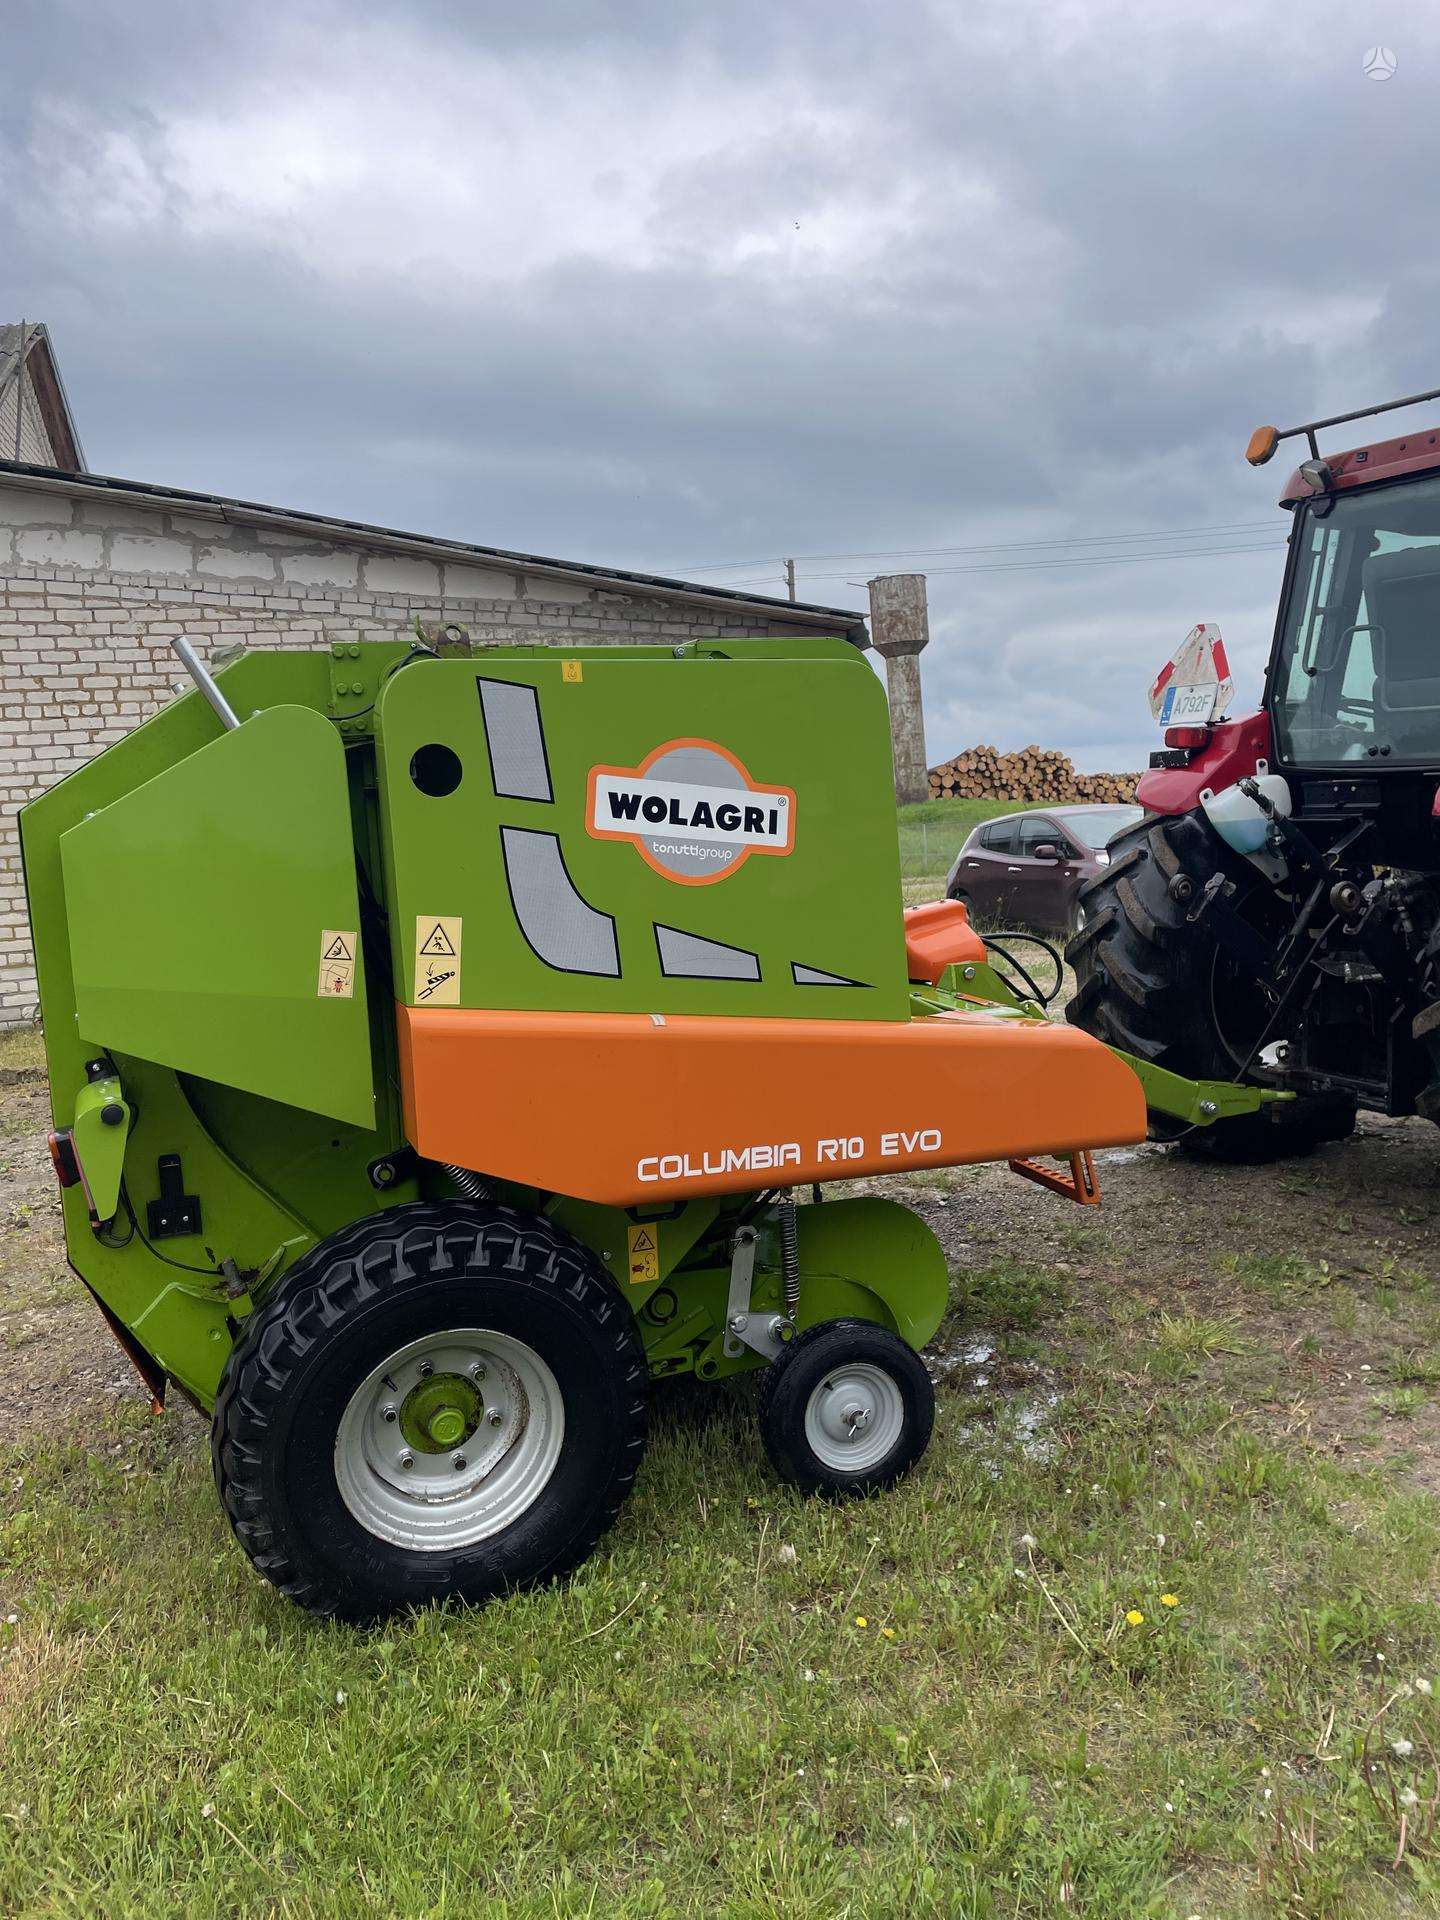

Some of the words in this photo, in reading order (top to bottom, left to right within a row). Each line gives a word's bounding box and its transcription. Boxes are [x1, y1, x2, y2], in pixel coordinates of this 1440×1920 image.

[1173, 694, 1212, 715] A792F
[608, 791, 778, 835] WOLAGRI
[652, 841, 732, 861] tonuttigroup
[637, 1142, 801, 1182] COLUMBIA
[817, 1136, 864, 1162] R10
[880, 1128, 942, 1156] EVO
